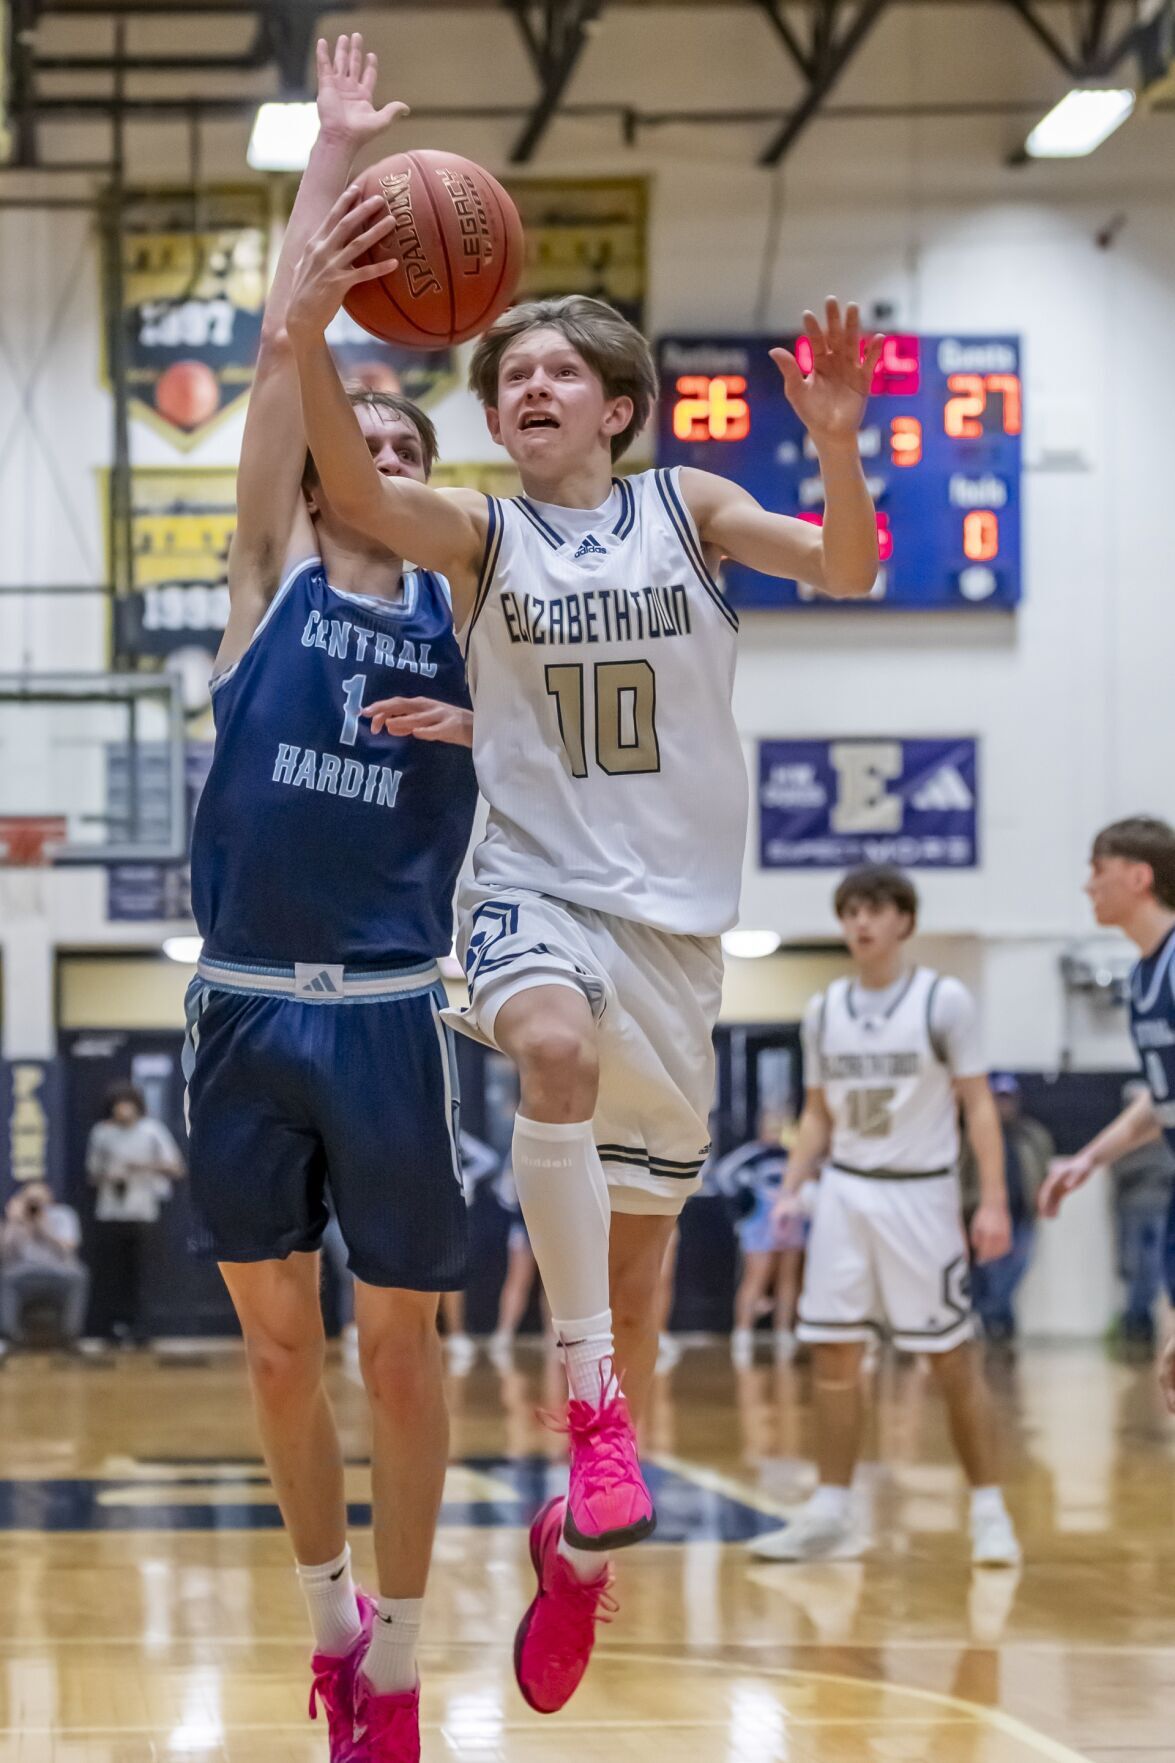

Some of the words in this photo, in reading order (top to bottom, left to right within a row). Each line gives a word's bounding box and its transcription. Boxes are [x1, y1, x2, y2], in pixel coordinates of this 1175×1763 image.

[378, 169, 442, 299] SPALDING
[436, 168, 480, 276] LEGACY
[673, 376, 750, 441] 26
[944, 374, 1022, 438] 27
[890, 416, 922, 467] 3
[574, 545, 607, 558] adidas
[963, 511, 998, 561] 0
[301, 609, 438, 679] CENTRAL
[500, 583, 692, 645] ELIZABETHTOWN
[339, 673, 367, 746] 1
[544, 659, 661, 778] 10
[271, 743, 403, 808] HARDIN
[829, 742, 902, 833] E
